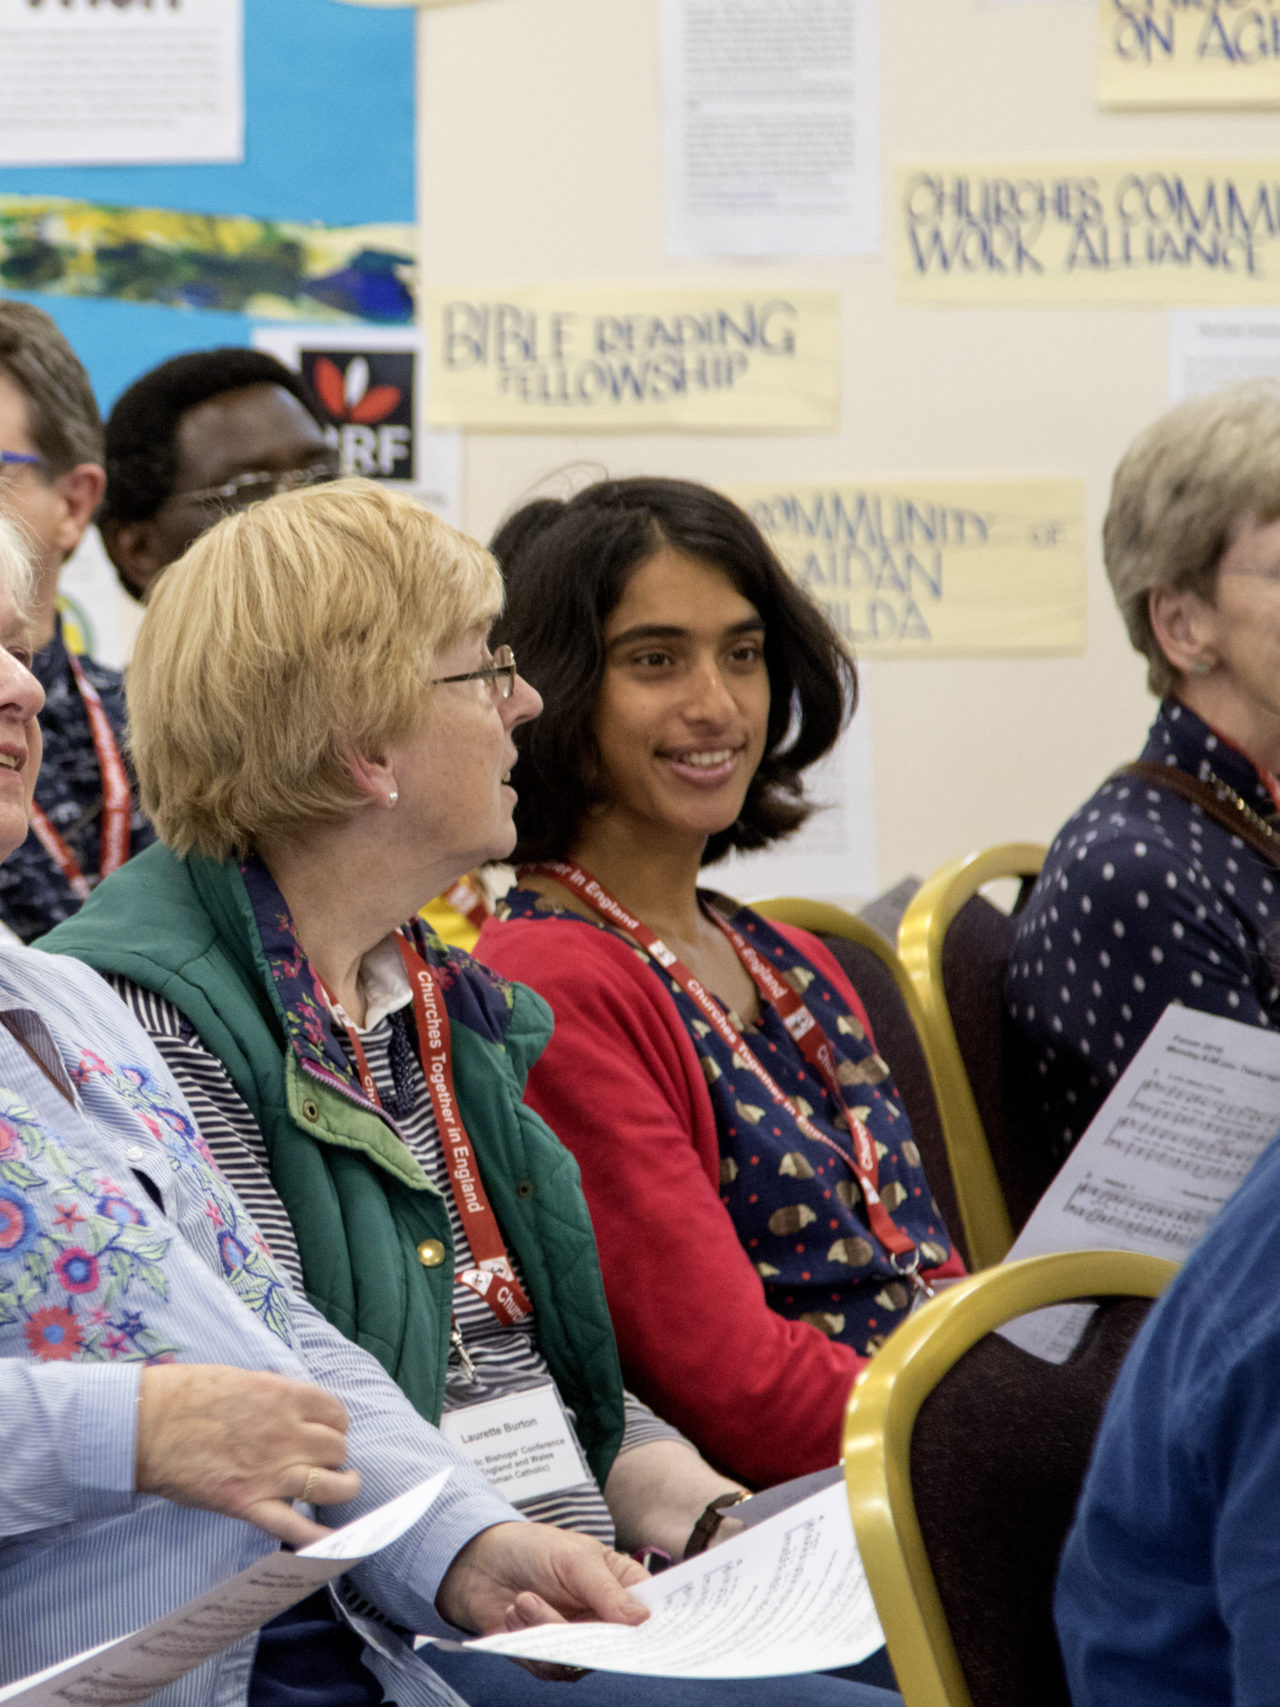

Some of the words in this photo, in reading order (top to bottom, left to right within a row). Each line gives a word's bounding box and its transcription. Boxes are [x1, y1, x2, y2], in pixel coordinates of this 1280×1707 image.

[1197, 8, 1280, 66] AG
[908, 220, 1044, 275] WORK
[443, 300, 576, 369] BIBLE
[594, 298, 797, 357] READING
[500, 350, 748, 405] FELLOWSHIP
[832, 597, 931, 640] ILDA
[585, 880, 640, 930] England
[742, 946, 788, 999] England
[417, 970, 443, 1049] Churches
[687, 978, 737, 1044] Churches
[738, 1043, 785, 1101] Together
[430, 1052, 455, 1125] Together
[447, 1125, 462, 1151] in
[453, 1145, 485, 1213] England
[497, 1286, 528, 1321] Churc
[461, 1426, 502, 1444] Laurette
[504, 1417, 538, 1433] Burton
[521, 1438, 565, 1454] Conference
[515, 1457, 530, 1467] and
[530, 1452, 555, 1463] Wales
